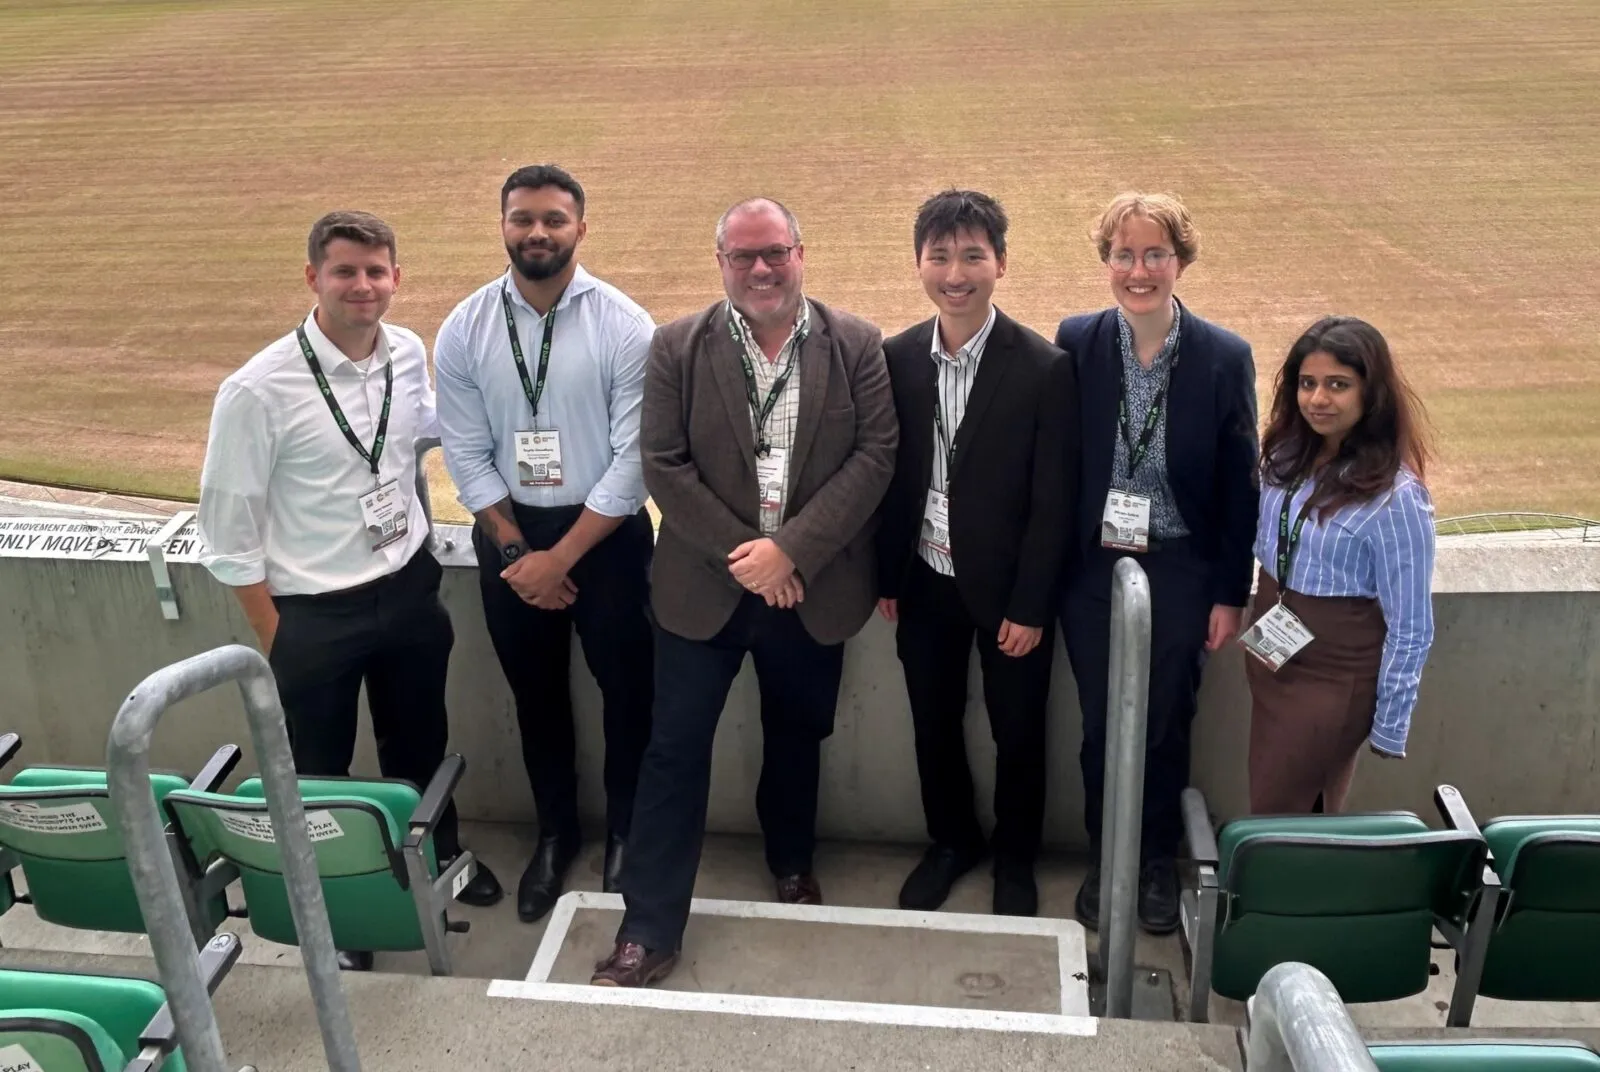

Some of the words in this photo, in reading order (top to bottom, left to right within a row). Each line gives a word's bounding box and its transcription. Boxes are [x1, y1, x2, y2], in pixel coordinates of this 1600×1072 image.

[0, 522, 13, 530] AT
[13, 522, 67, 532] MOVEMENT
[41, 535, 96, 552] MOVE
